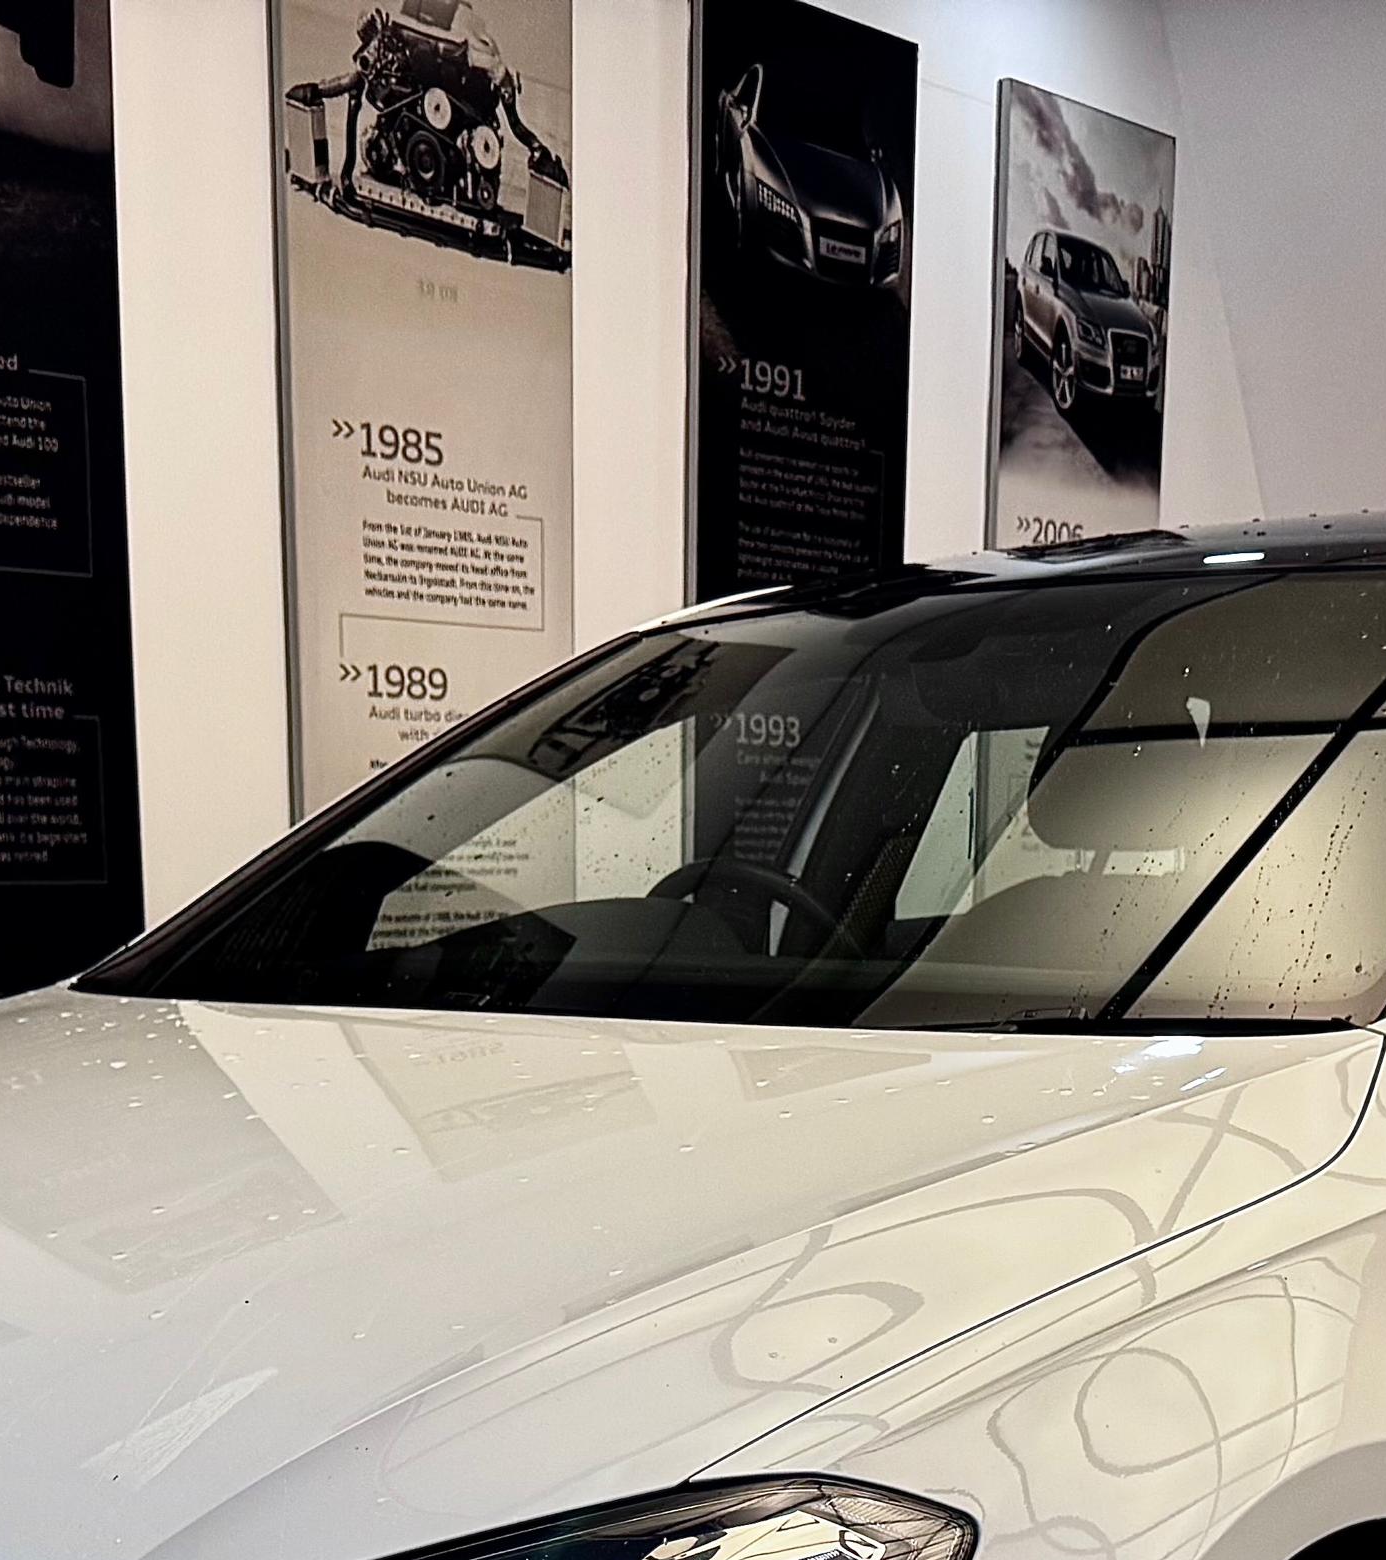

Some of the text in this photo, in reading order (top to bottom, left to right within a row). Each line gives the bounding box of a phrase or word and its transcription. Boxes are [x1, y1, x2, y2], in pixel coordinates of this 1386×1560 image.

[741, 358, 805, 401] 1991
[741, 396, 767, 414] Audi
[360, 422, 443, 466] 1985
[363, 464, 527, 500] Audi NSU Auto Union AG
[386, 490, 508, 518] becomes AUDI AG
[3, 674, 73, 695] Technik
[367, 664, 448, 700] 1989
[21, 700, 65, 720] time
[369, 706, 400, 720] Audi
[404, 708, 440, 722] turbo
[398, 729, 429, 741] with
[735, 713, 800, 747] 1993
